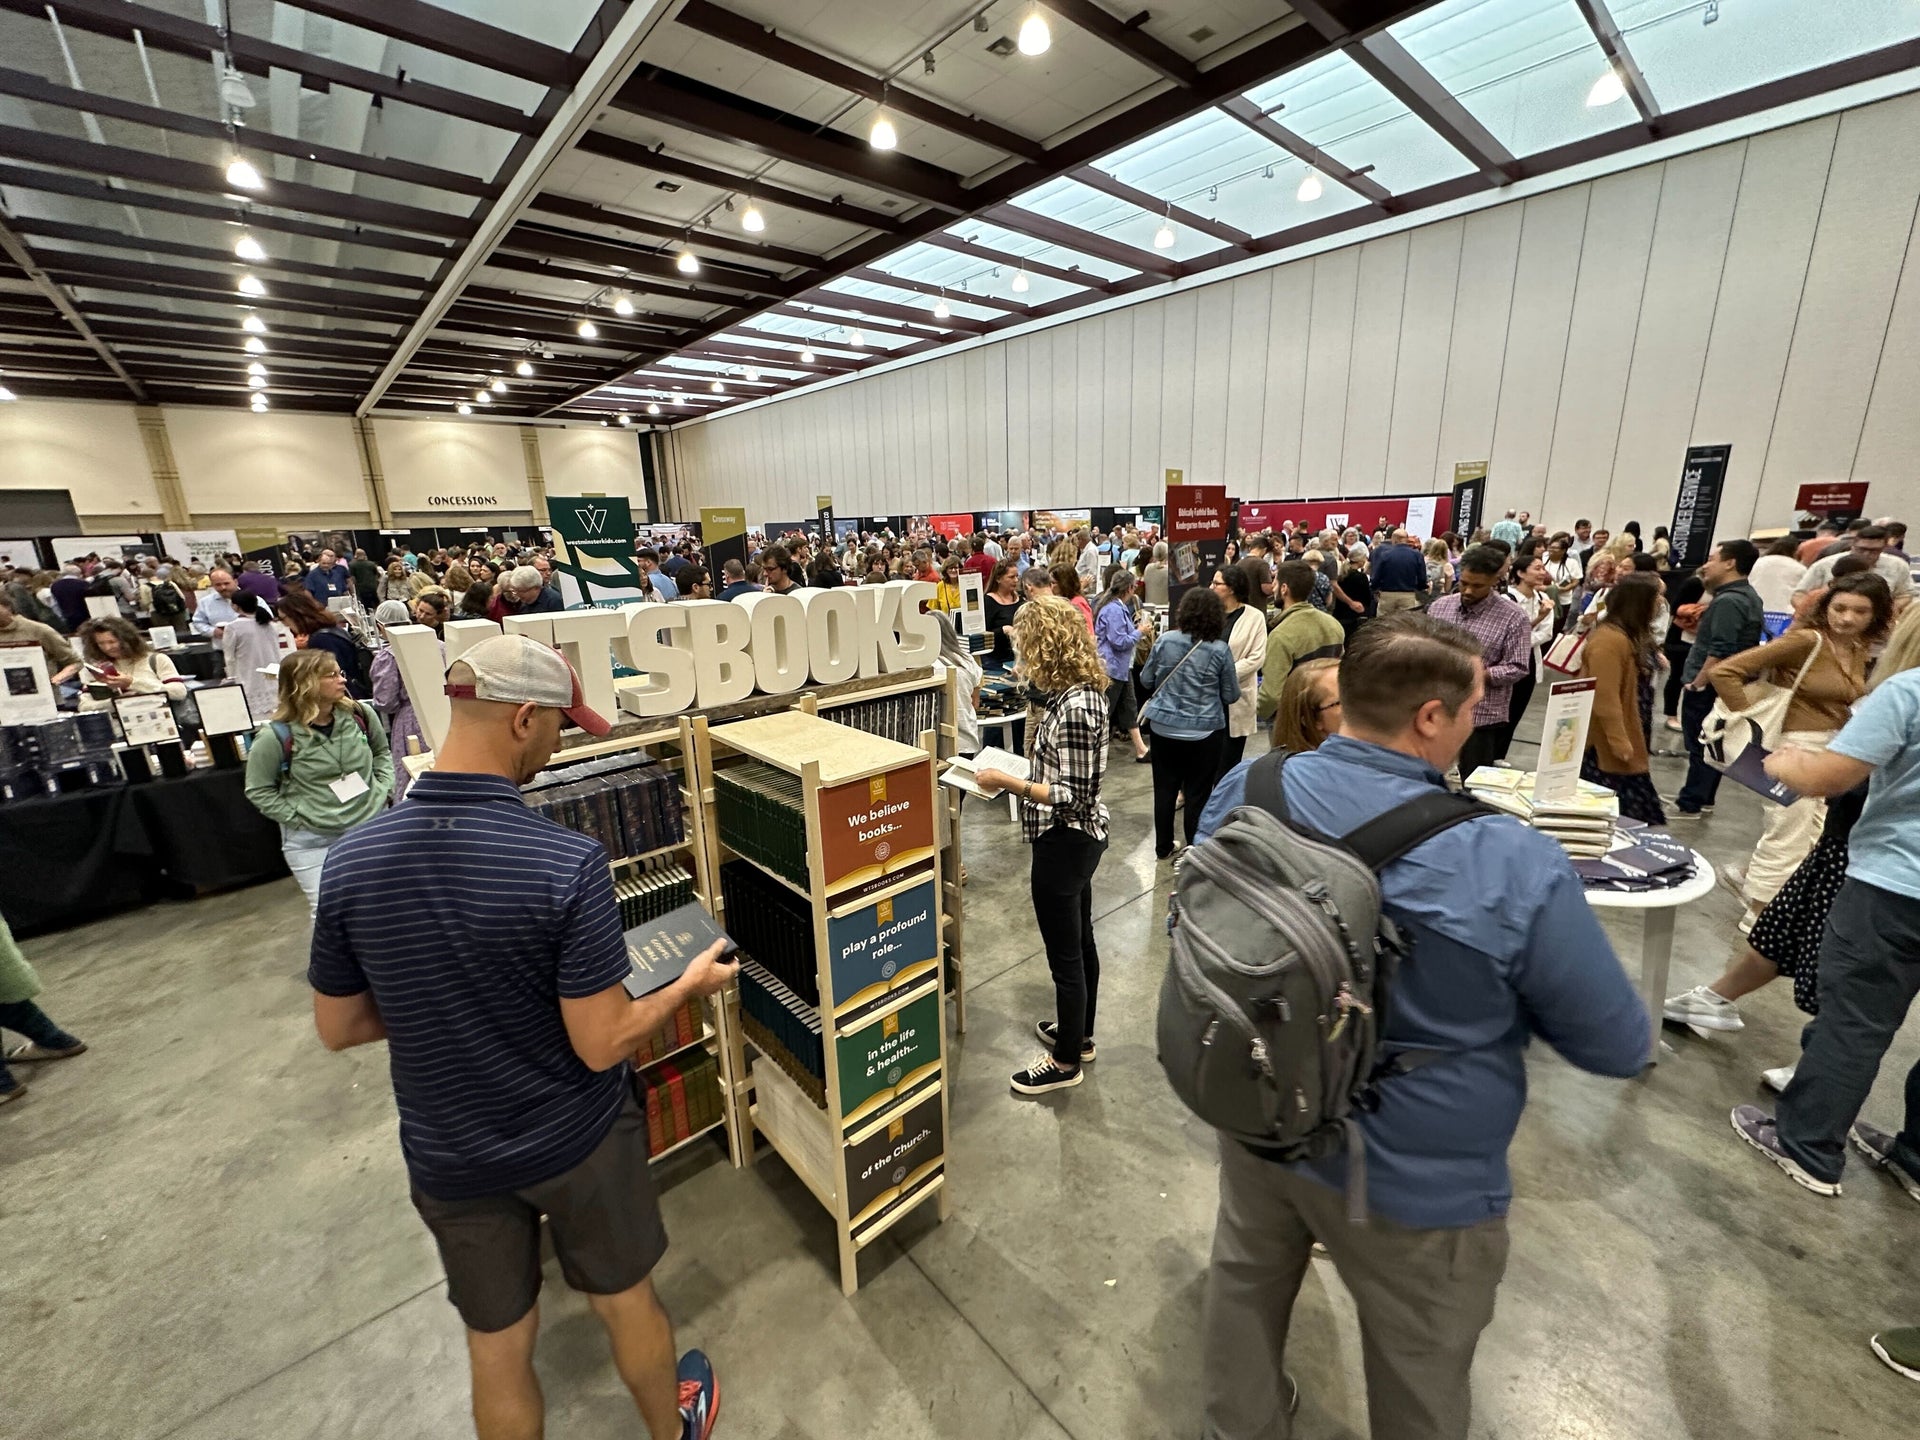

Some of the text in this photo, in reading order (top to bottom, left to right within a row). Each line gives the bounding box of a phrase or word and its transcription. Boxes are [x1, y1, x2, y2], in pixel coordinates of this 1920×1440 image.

[428, 496, 498, 505] CONCESSIONS
[1460, 488, 1474, 518] STATION
[1672, 467, 1702, 560] CUSTOMER SERVICE
[566, 538, 627, 546] westminsterkids.com
[257, 559, 275, 577] CUS
[847, 800, 910, 828] We believe
[858, 823, 903, 842] books...
[863, 873, 905, 893] WTSBOOKS.COM
[842, 909, 928, 960] play a profound
[872, 942, 903, 960] role...
[867, 1028, 916, 1061] in the life
[866, 1044, 919, 1077] & health...
[861, 1128, 932, 1180] of the Church.
